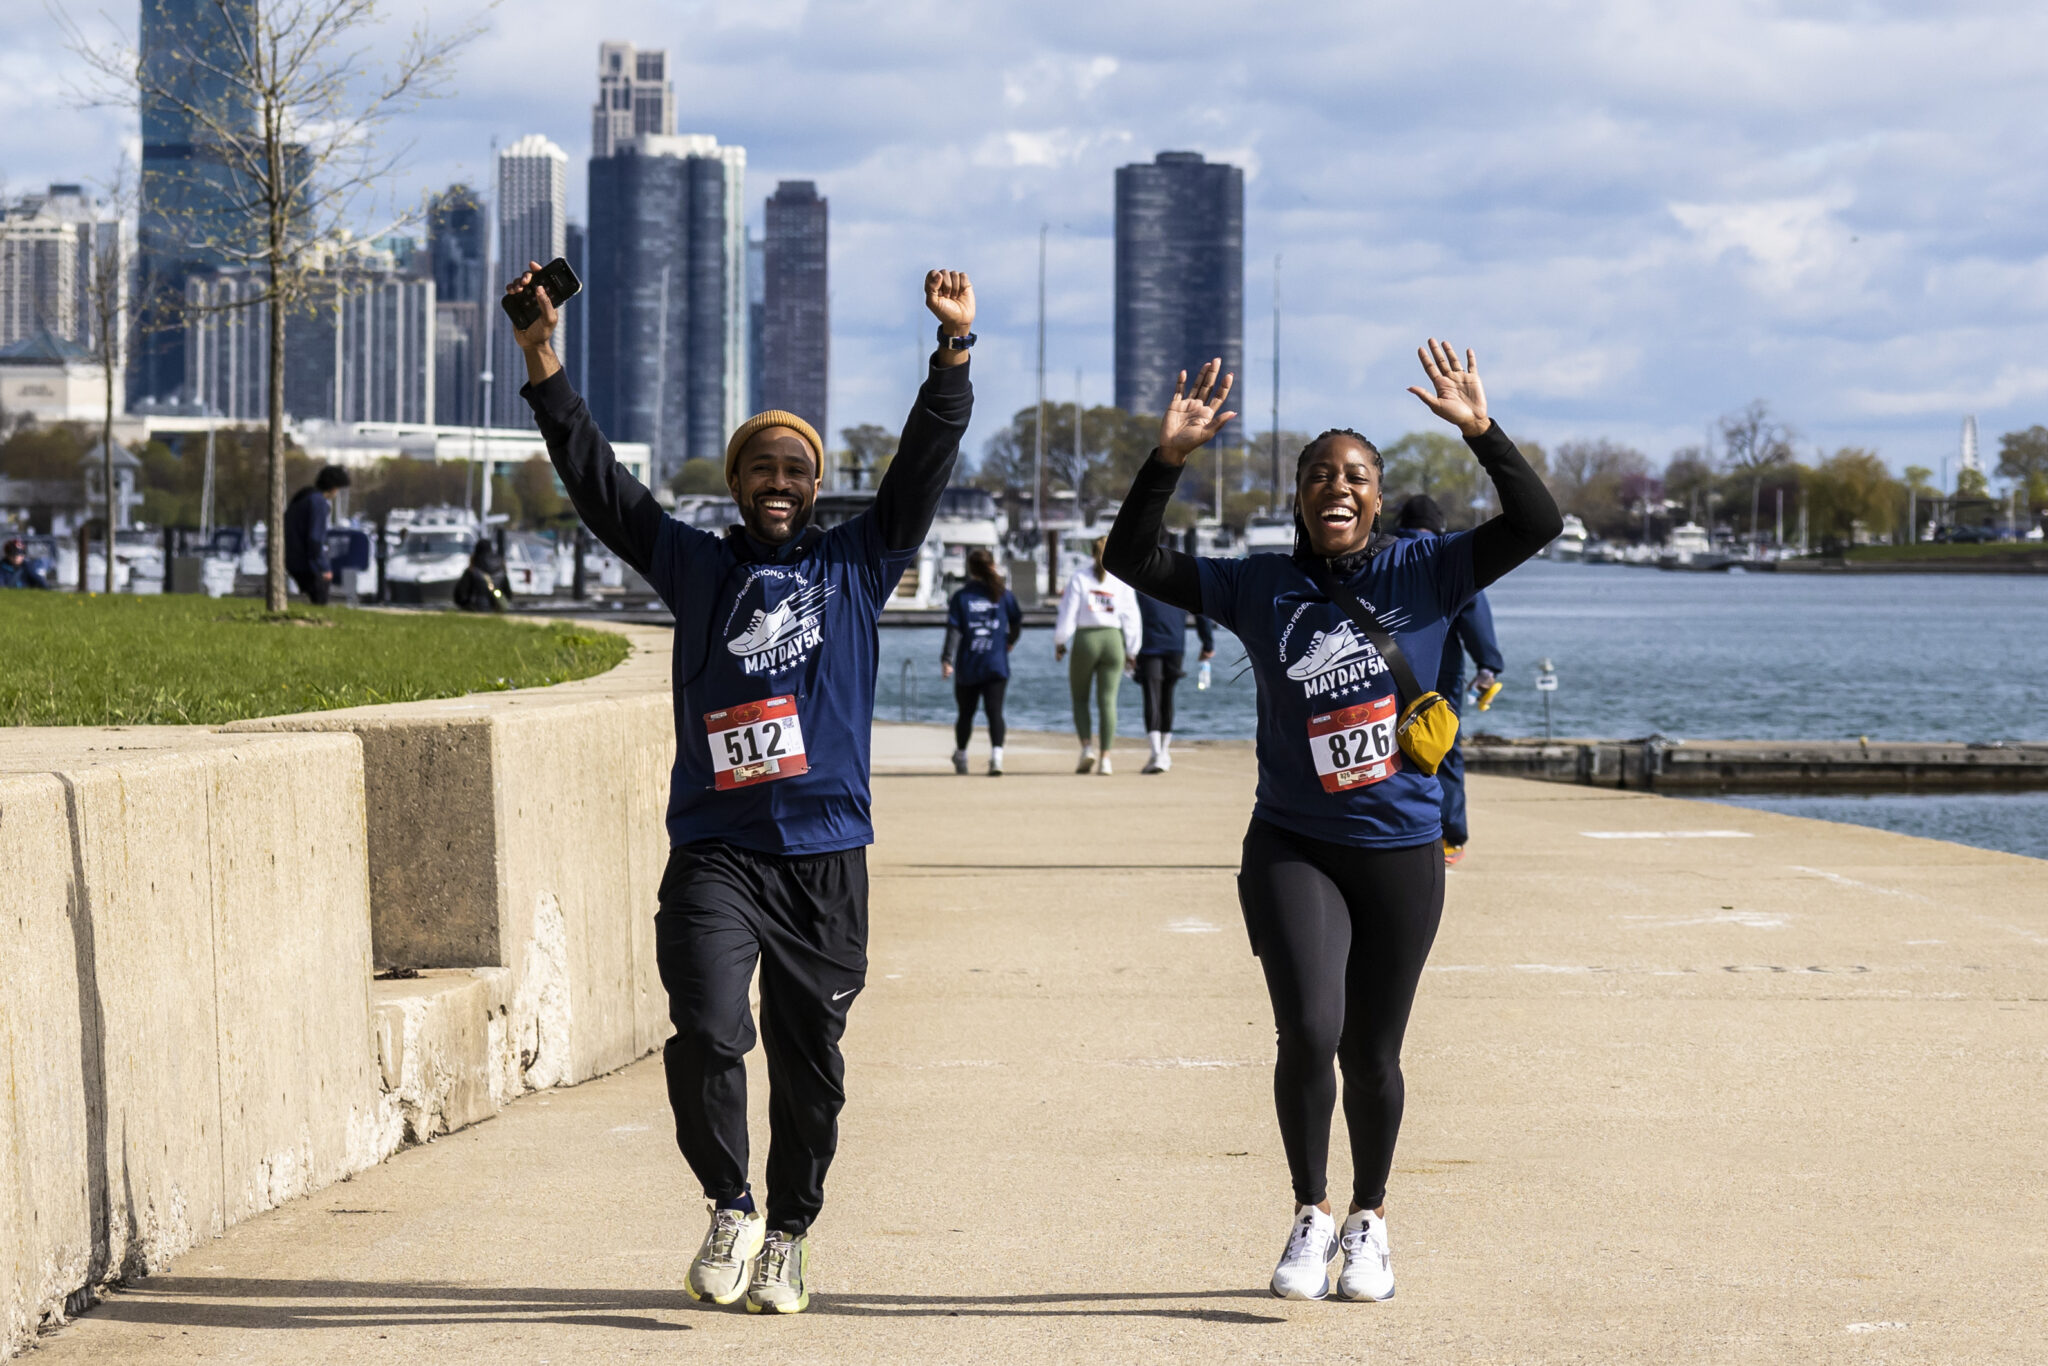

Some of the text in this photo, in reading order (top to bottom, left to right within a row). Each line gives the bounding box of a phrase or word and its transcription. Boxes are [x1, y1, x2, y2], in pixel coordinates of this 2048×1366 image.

[1279, 623, 1294, 663] CHICAGO
[723, 722, 786, 766] 512
[1328, 723, 1389, 769] 826
